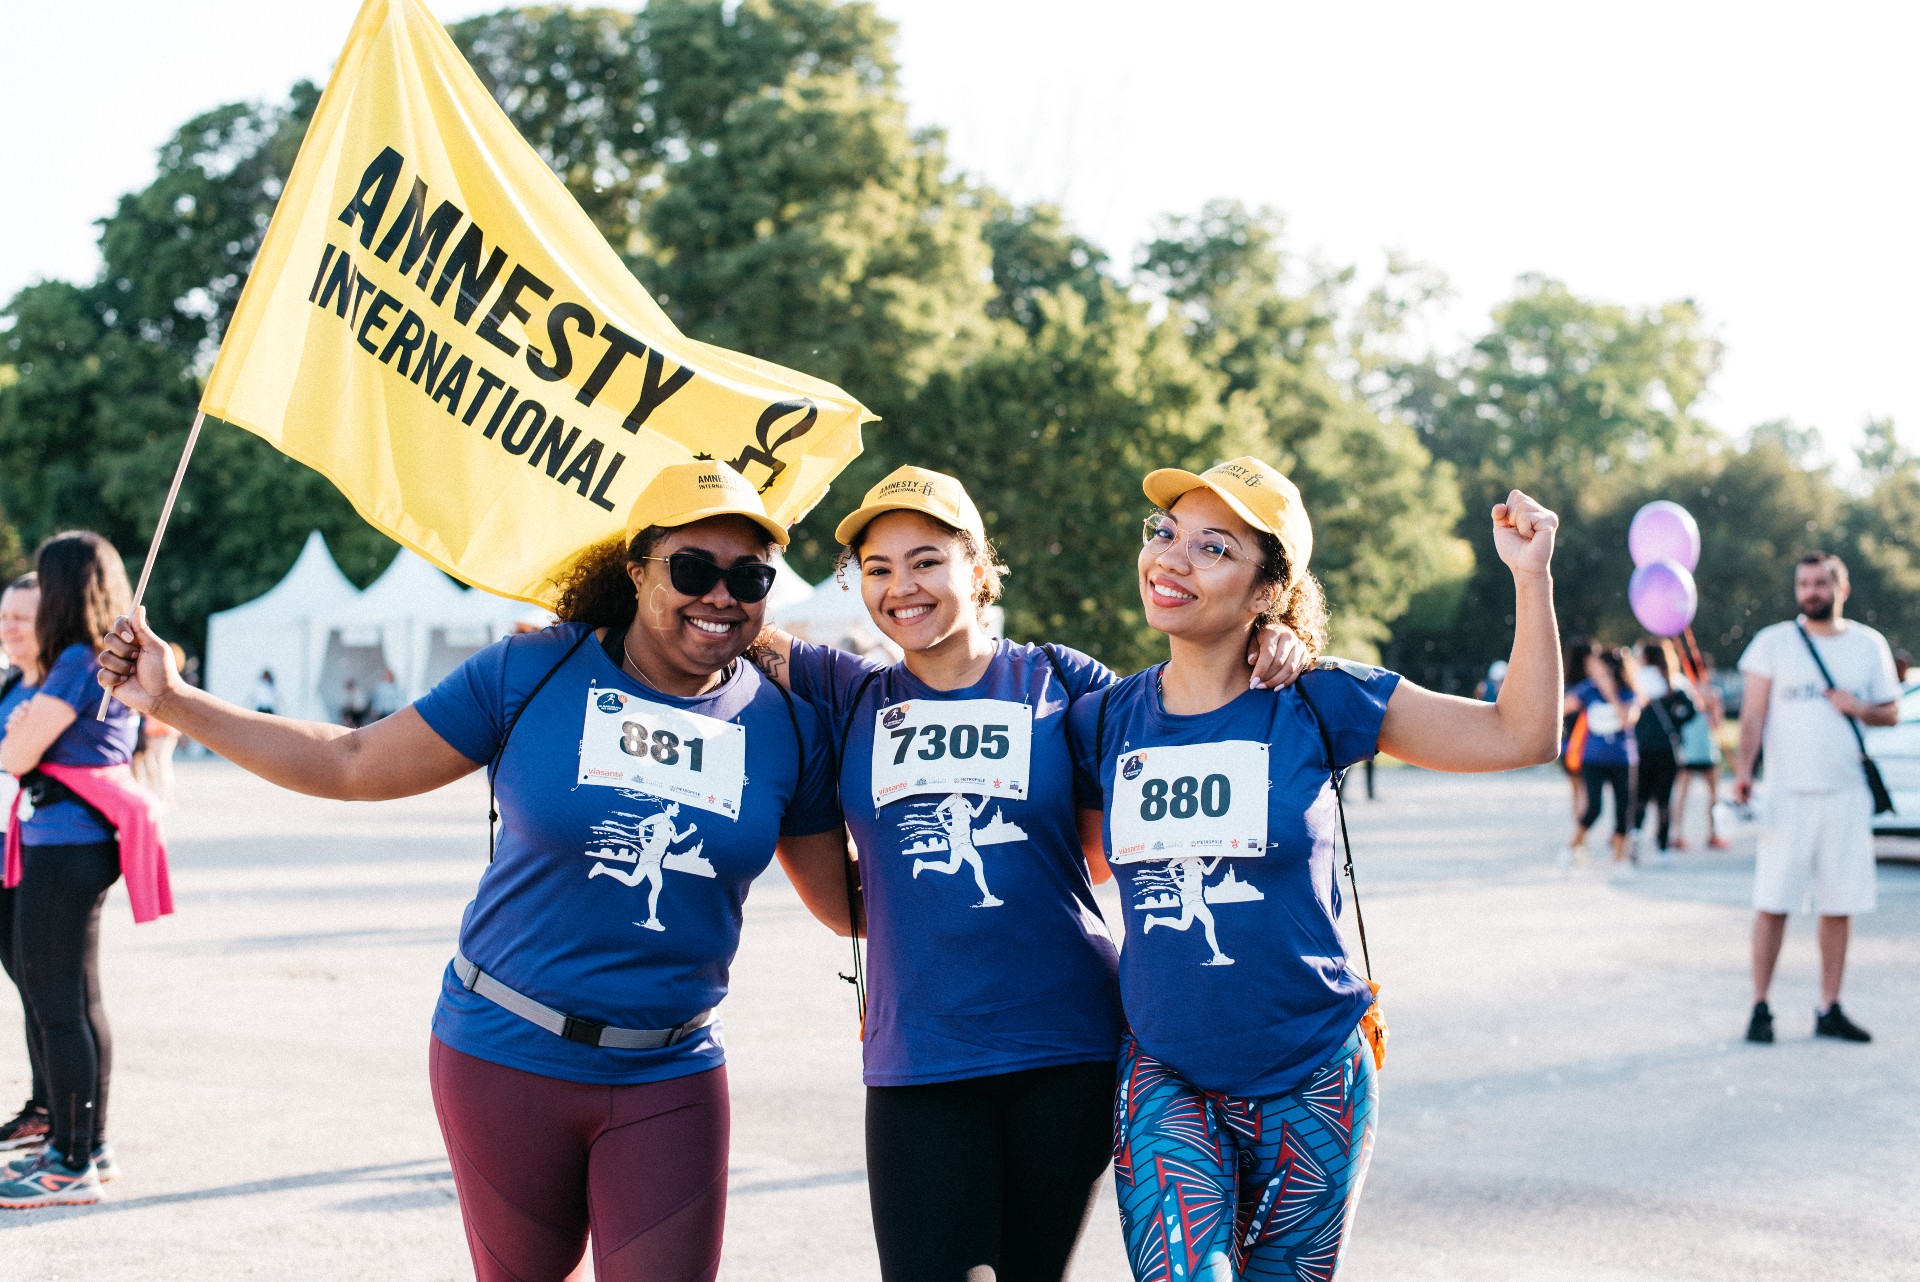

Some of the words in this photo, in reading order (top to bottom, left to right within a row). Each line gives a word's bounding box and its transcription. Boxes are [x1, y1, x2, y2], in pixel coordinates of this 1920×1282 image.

[337, 145, 697, 435] AMNESTY
[307, 243, 627, 513] INTERNATIONAL
[879, 481, 919, 494] AMNESTY
[619, 720, 704, 773] 881
[890, 724, 1010, 766] 7305
[588, 767, 624, 778] viasanté
[1140, 773, 1231, 822] 880
[1118, 843, 1145, 855] viasanté
